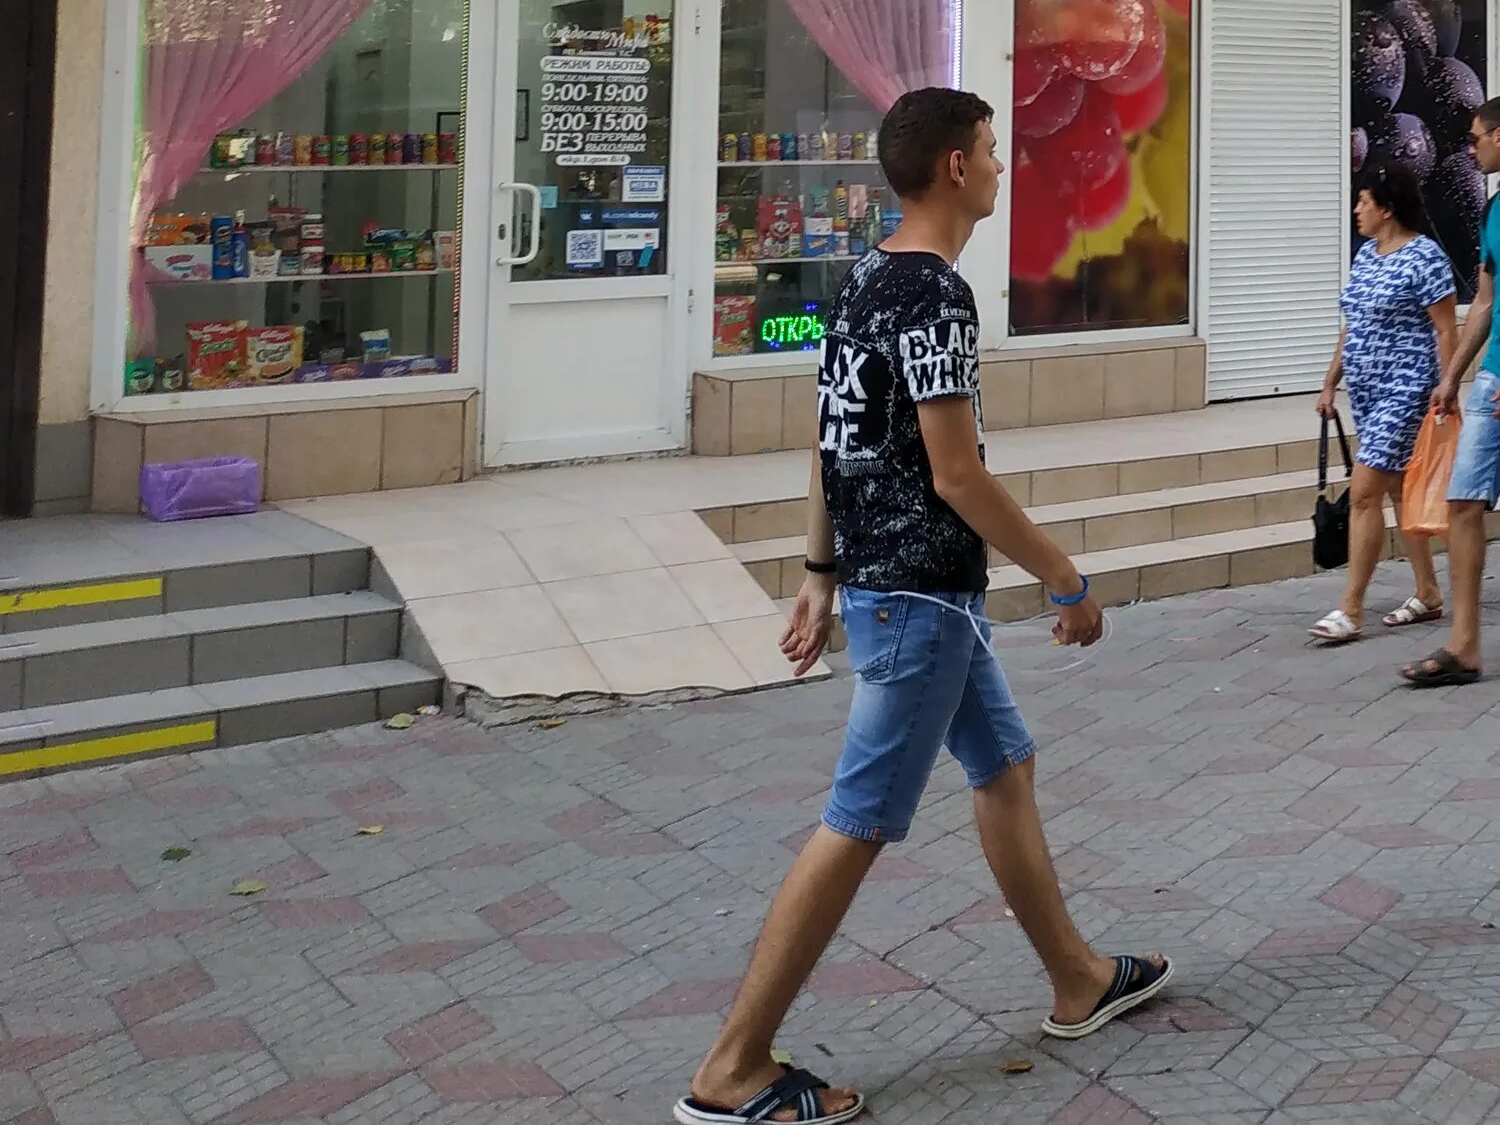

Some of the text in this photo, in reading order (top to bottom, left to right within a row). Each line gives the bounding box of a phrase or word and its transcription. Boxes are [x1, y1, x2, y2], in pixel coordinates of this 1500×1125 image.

[543, 59, 592, 70] РЕЖИМ
[541, 83, 648, 102] 9:00-19:00
[540, 113, 648, 131] 9:00-15:00
[540, 132, 584, 152] БЕЗ
[907, 322, 978, 360] BLAC
